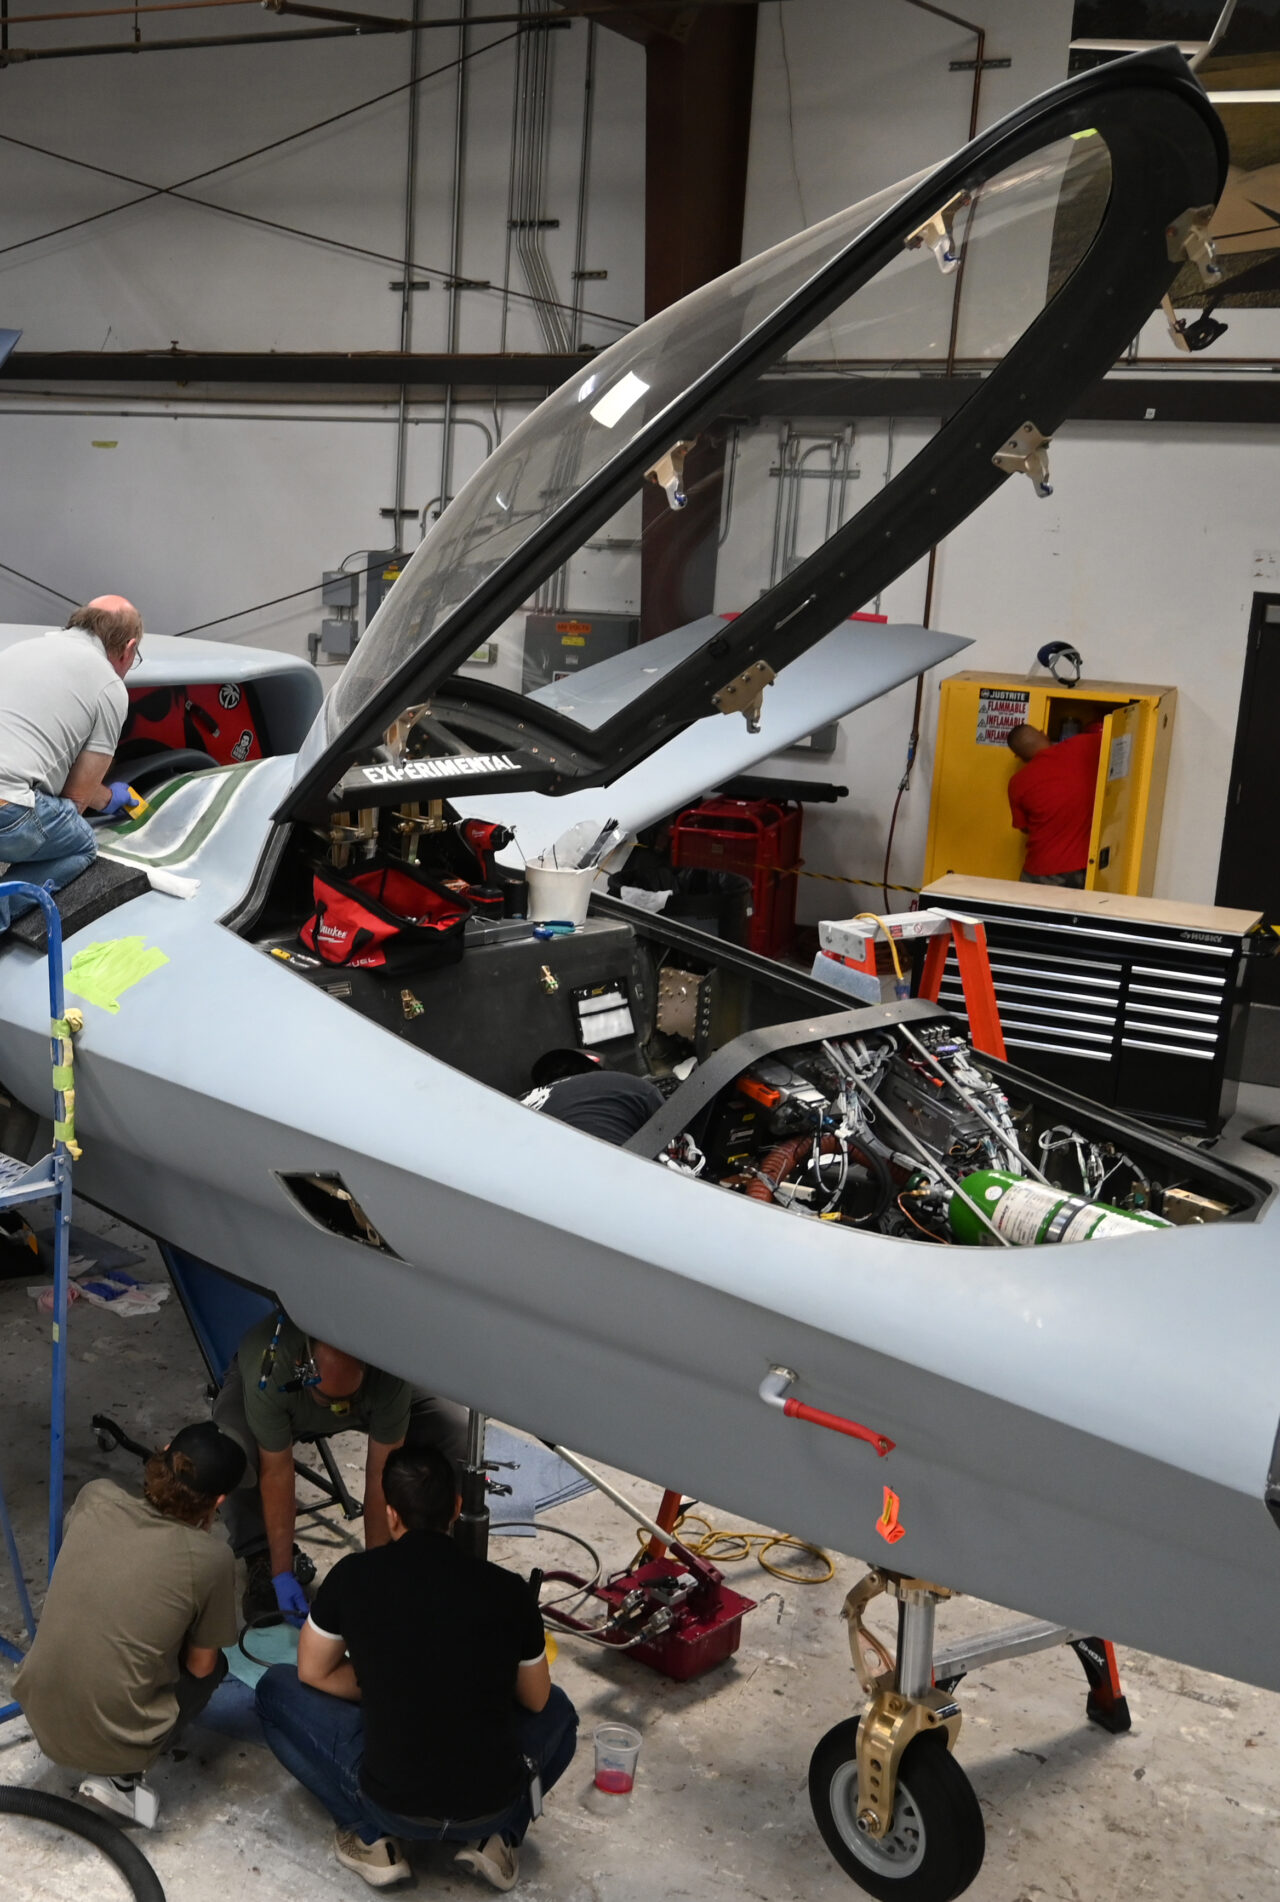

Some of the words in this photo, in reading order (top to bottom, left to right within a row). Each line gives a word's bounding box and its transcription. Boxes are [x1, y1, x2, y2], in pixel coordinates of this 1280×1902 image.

[989, 691, 1026, 700] JUSTRITE
[987, 701, 1026, 714] FLAMMABLE
[362, 755, 522, 784] EXPERIMENTAL
[1191, 932, 1223, 943] HUSKY
